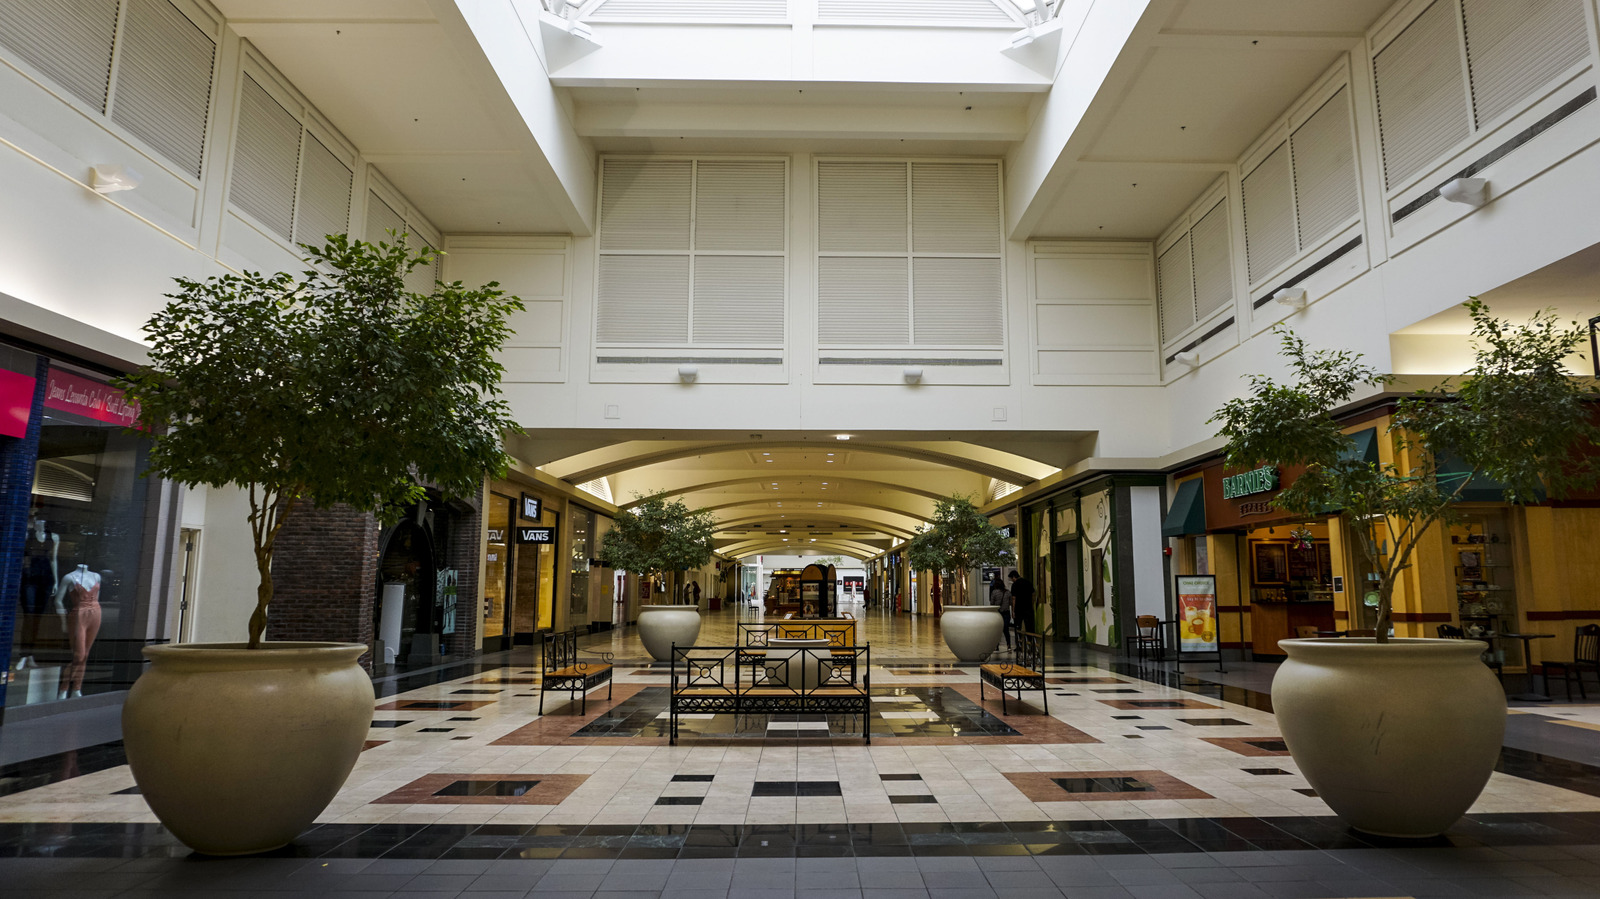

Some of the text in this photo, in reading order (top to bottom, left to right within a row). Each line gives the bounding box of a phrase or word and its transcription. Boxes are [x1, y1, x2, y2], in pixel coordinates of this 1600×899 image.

[48, 379, 66, 401] Jeans
[524, 497, 538, 518] VANS
[522, 530, 549, 541] VANS
